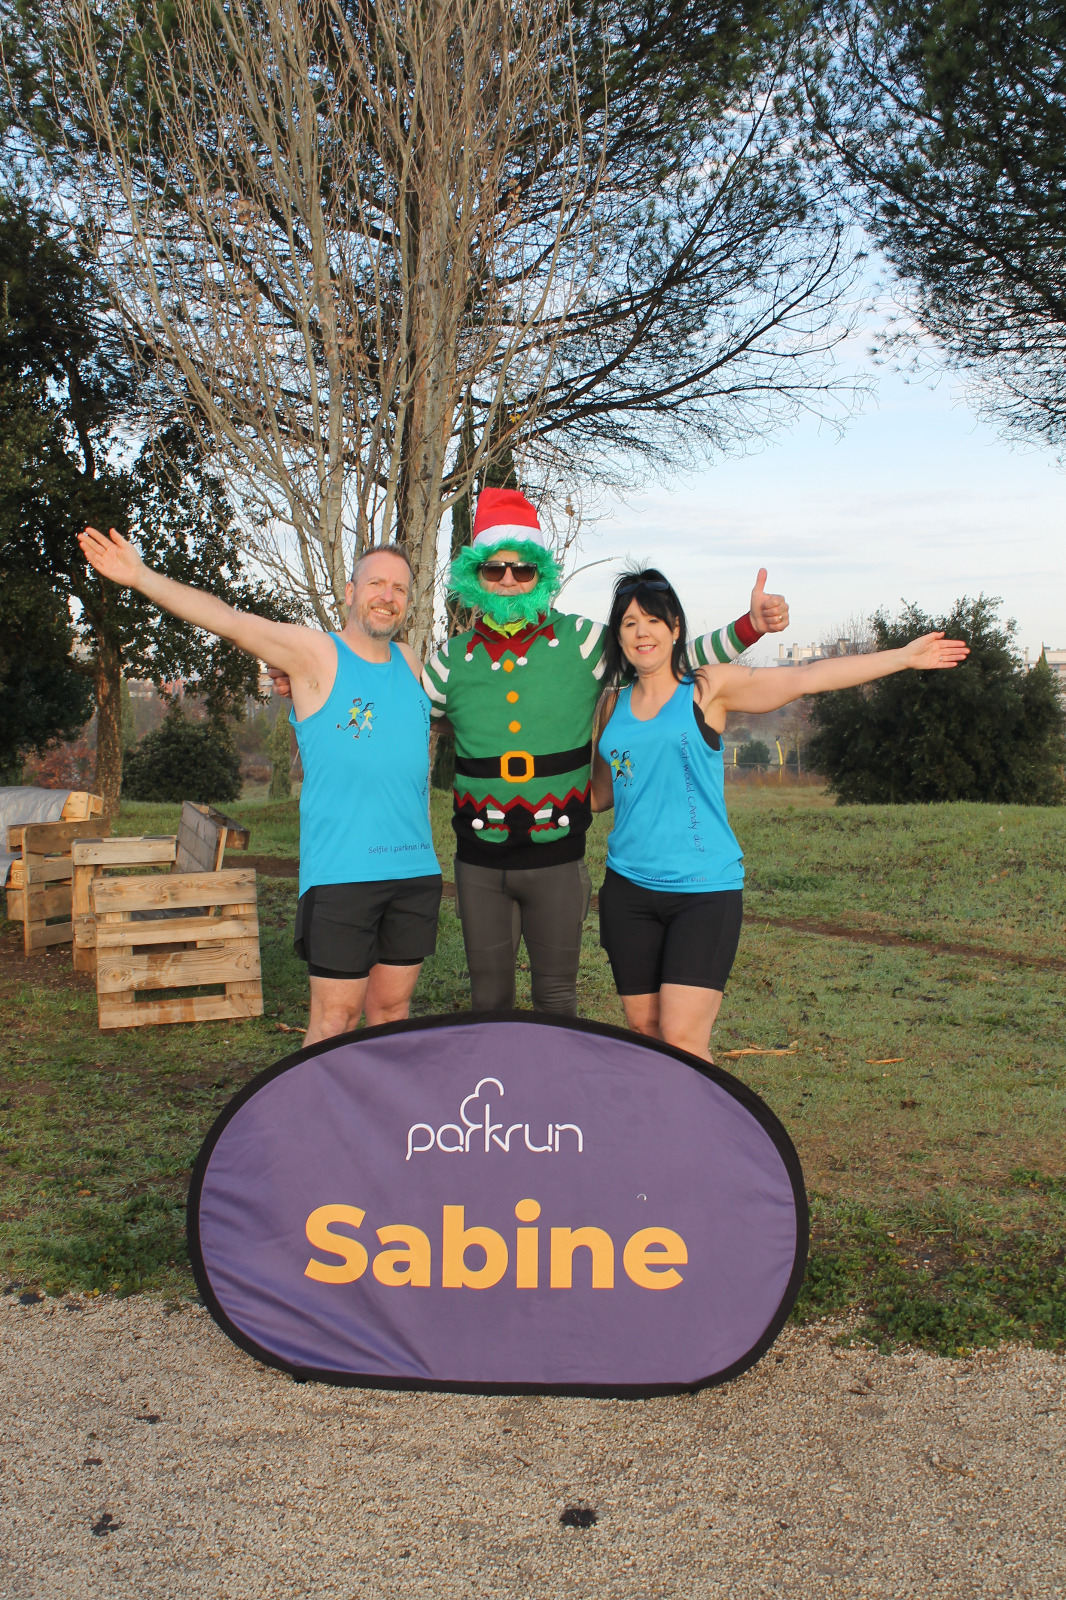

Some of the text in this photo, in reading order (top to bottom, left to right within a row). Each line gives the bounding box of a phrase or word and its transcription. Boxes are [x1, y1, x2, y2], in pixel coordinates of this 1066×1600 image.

[681, 731, 690, 760] What
[684, 763, 695, 793] would
[368, 845, 389, 854] Selfie
[405, 1077, 584, 1161] parkrun
[303, 1198, 689, 1290] Sabine
